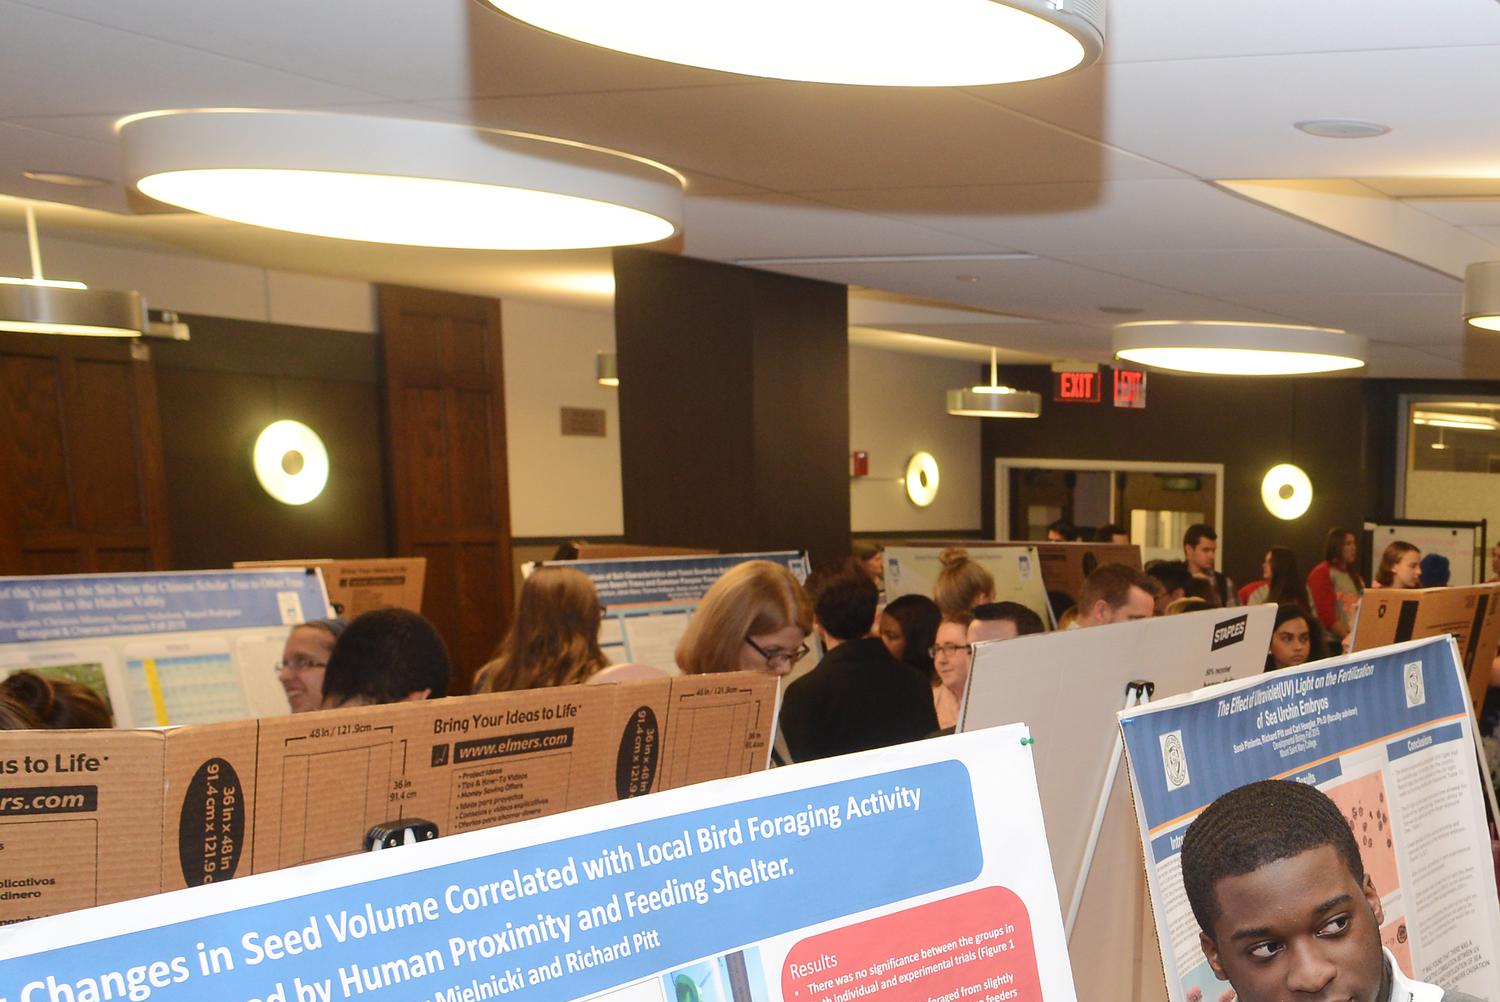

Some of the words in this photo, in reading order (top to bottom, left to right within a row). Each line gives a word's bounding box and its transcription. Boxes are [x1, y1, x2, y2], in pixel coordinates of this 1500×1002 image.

[1061, 372, 1094, 399] EXIT
[1214, 621, 1245, 643] STAPLES
[1218, 701, 1230, 717] The
[1230, 695, 1249, 714] Effect
[1296, 676, 1314, 695] Light
[1315, 677, 1325, 689] on
[1325, 672, 1337, 687] the
[1337, 664, 1375, 683] Fertilization
[433, 717, 469, 734] Bring
[472, 714, 504, 729] Your
[506, 709, 540, 725] Ideas
[542, 707, 554, 720] to
[556, 704, 577, 719] Life
[1257, 712, 1264, 729] of
[1265, 710, 1278, 726] Sea
[1278, 703, 1300, 722] Urchin
[1299, 697, 1329, 716] Embryos
[459, 733, 568, 759] www.elmers.com
[1407, 735, 1433, 751] Conclusions
[24, 756, 49, 774] to
[56, 753, 100, 773] Life
[207, 763, 220, 796] 91.4
[223, 786, 235, 805] 36
[206, 798, 215, 820] cm
[222, 807, 235, 822] in
[205, 823, 214, 832] x
[222, 824, 231, 832] x
[204, 835, 217, 873] 121.9
[221, 835, 233, 854] 48
[220, 856, 233, 871] in
[197, 942, 234, 976] in
[241, 916, 322, 965] Seed
[325, 898, 439, 943] Volume
[445, 856, 579, 914] Correlated
[582, 845, 634, 880] with
[637, 830, 693, 867] Local
[696, 819, 743, 853] Bird
[747, 804, 842, 842] Foraging
[846, 786, 920, 820] Activity
[0, 890, 41, 900] dinero
[338, 950, 445, 998] Human
[448, 914, 570, 966] Proximity
[577, 894, 622, 931] and
[624, 878, 709, 917] Feeding
[711, 858, 794, 894] Shelter.
[528, 956, 563, 985] and
[565, 936, 631, 973] Richard
[633, 929, 660, 953] Pitt
[790, 954, 838, 980] Results
[807, 980, 834, 995] There
[834, 973, 854, 986] was
[855, 969, 867, 980] no
[869, 953, 919, 976] significance
[920, 941, 958, 959] between
[958, 936, 974, 947] the
[975, 928, 1004, 945] groups
[1005, 924, 1014, 934] in
[880, 974, 898, 990] and
[898, 956, 954, 983] experimental
[954, 951, 977, 965] trials
[978, 943, 1007, 960] (Figure
[1009, 939, 1015, 949] 1
[960, 984, 982, 997] from
[983, 973, 1013, 990] slightly
